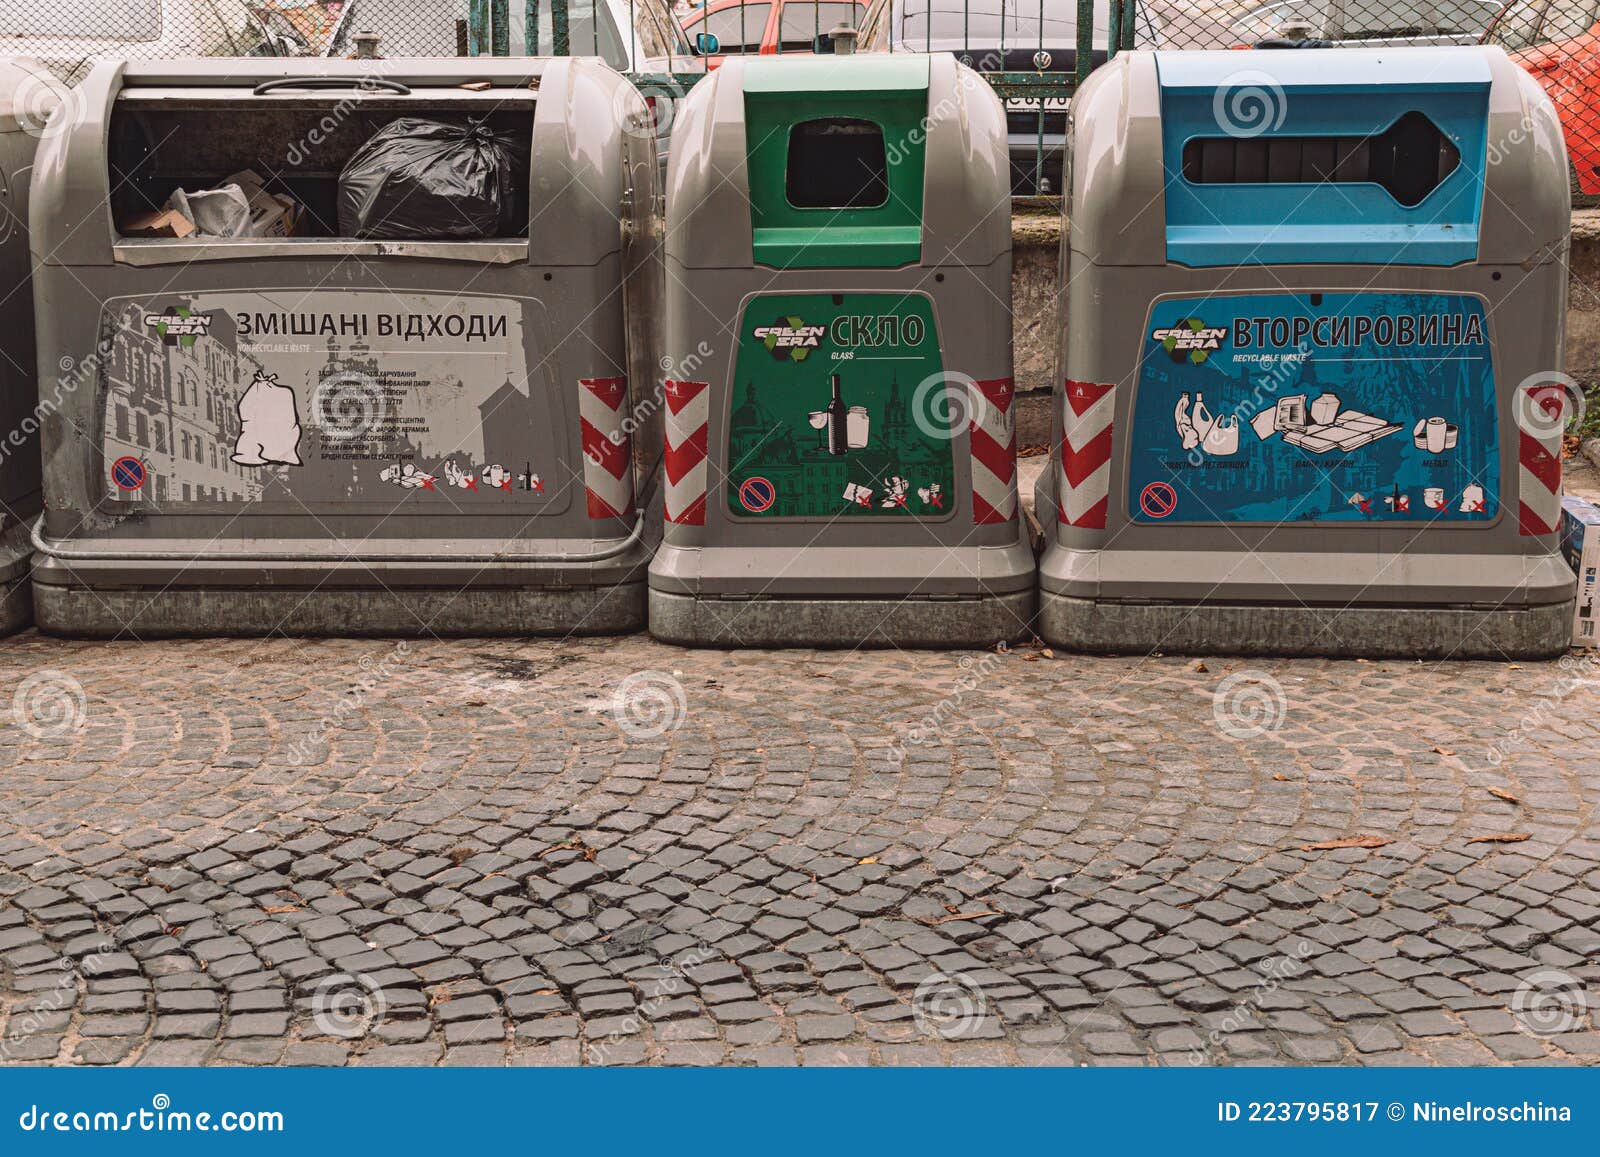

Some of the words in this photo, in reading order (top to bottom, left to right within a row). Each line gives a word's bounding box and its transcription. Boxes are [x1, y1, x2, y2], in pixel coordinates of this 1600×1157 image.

[236, 312, 368, 336] ЗМІШАНІ
[377, 313, 508, 342] ВІДХОДИ
[830, 314, 925, 347] СКЛО
[1232, 314, 1484, 349] ВТОРСИРОВИНА
[775, 336, 820, 347] ERA
[1174, 338, 1220, 350] ERA
[831, 351, 854, 360] GLASS
[1232, 354, 1279, 363] RECYCLABLE
[1280, 353, 1307, 362] WASTE
